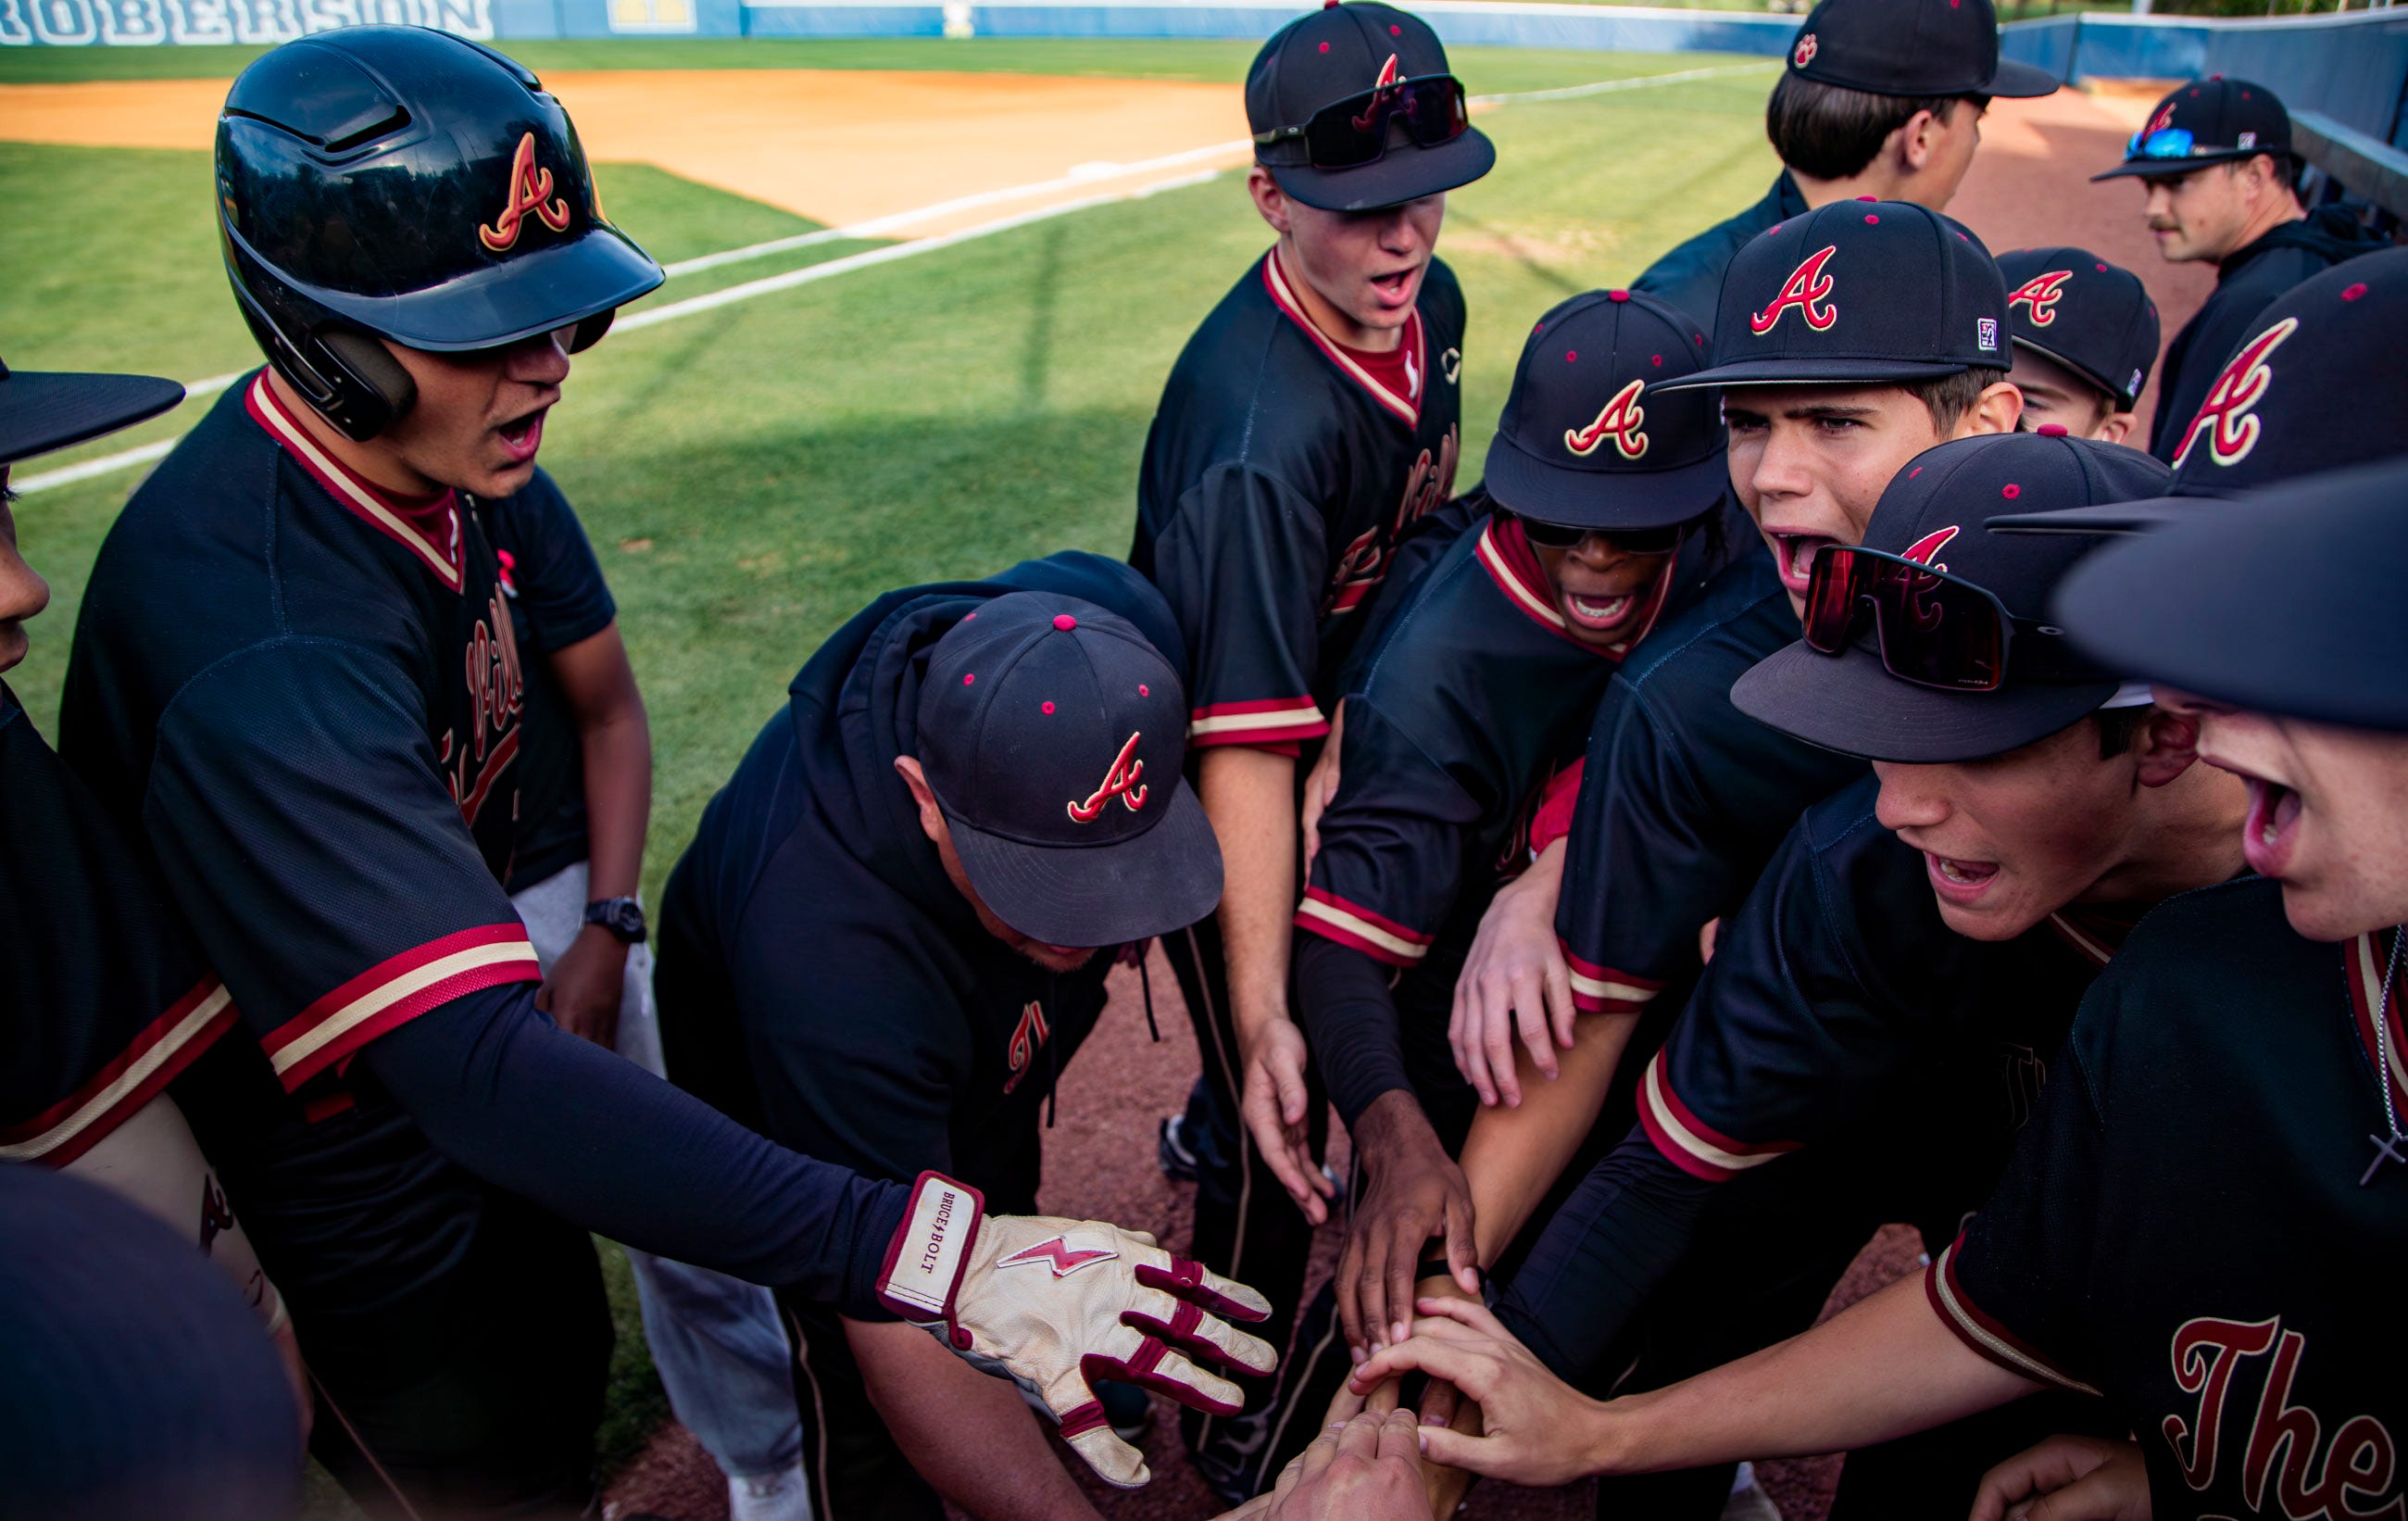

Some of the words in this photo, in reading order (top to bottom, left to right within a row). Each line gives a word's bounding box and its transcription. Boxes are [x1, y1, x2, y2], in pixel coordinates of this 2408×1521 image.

[479, 132, 571, 252] A
[1750, 245, 1837, 335] A
[2008, 270, 2074, 328] A
[1564, 379, 1649, 460] A
[2171, 317, 2299, 470] A
[1067, 731, 1148, 823] A
[921, 1232, 944, 1275] BOLT
[935, 1191, 956, 1226] BRUCE
[2161, 1313, 2408, 1521] The
